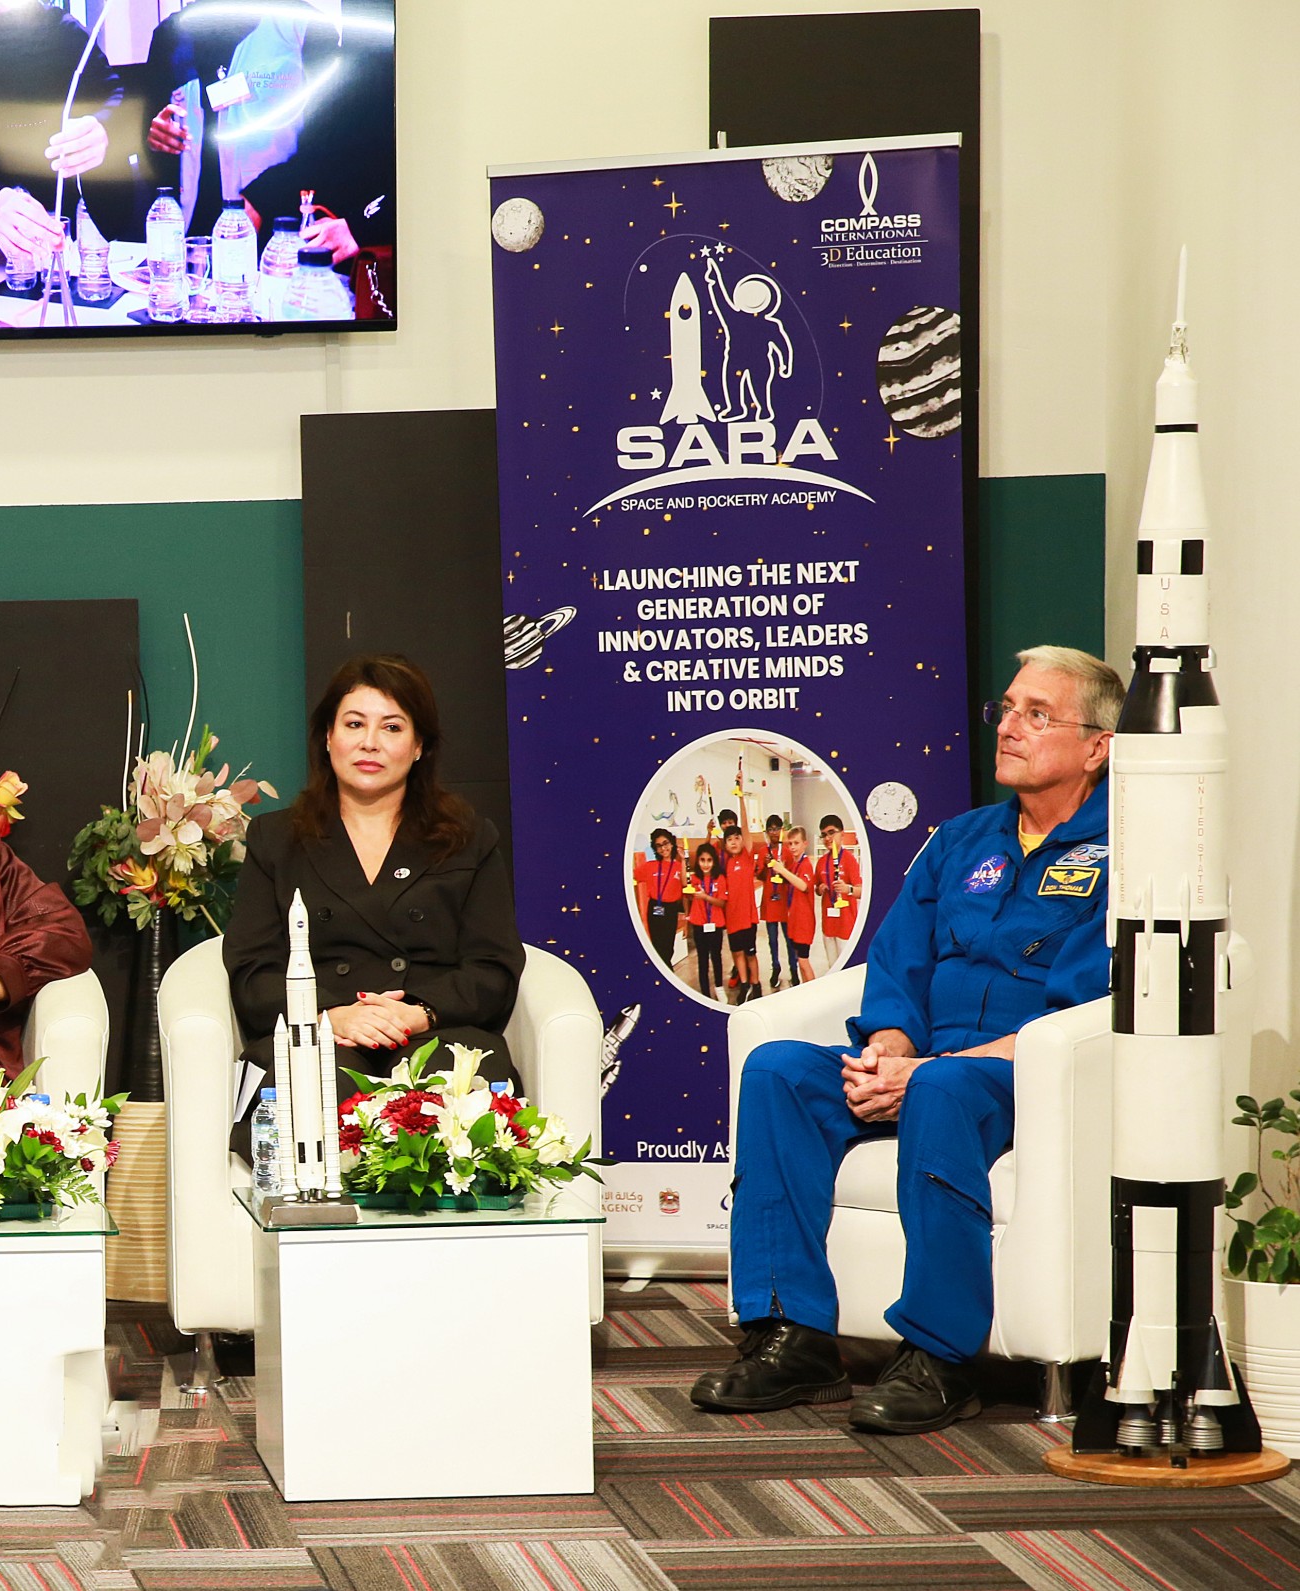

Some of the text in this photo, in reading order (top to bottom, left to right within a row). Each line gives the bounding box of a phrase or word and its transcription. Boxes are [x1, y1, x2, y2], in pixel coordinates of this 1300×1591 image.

[821, 214, 921, 232] COMPASS
[821, 229, 921, 242] INTERNATIONAL
[820, 244, 921, 267] 3D Education
[616, 418, 839, 470] SARA
[621, 490, 837, 511] SPACE AND ROCKETRY ACADEMY
[603, 560, 859, 591] LAUNCHING THE NEXT
[636, 593, 825, 621] GENERATION OF
[598, 623, 869, 652] INNOVATORS, LEADERS
[623, 655, 844, 683] & CREATIVE MINDS
[667, 687, 800, 713] INTO ORBIT
[972, 870, 1001, 879] NASA
[637, 1141, 708, 1163] Proudly
[615, 1191, 643, 1202] وكالة
[601, 1204, 643, 1212] AGENCY
